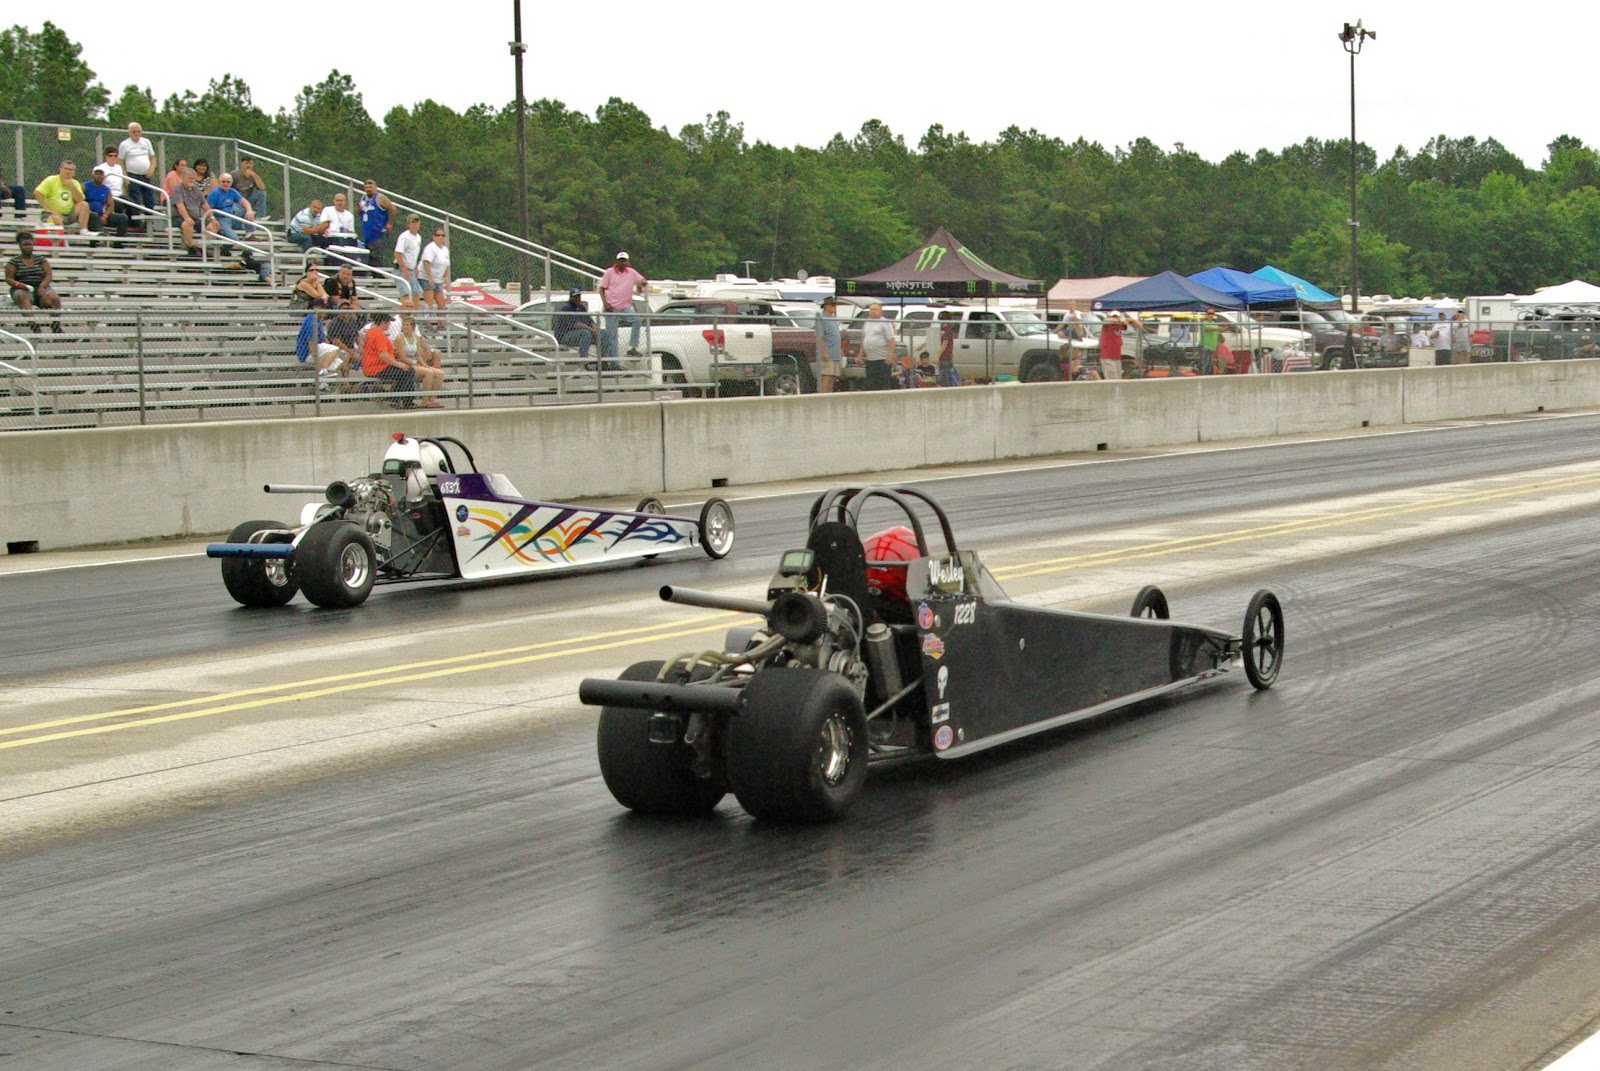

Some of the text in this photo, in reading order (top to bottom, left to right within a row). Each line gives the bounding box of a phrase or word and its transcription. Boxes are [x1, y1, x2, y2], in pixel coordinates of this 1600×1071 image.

[886, 281, 935, 290] MONSTER
[928, 556, 964, 592] Wesley
[954, 601, 977, 624] 1228
